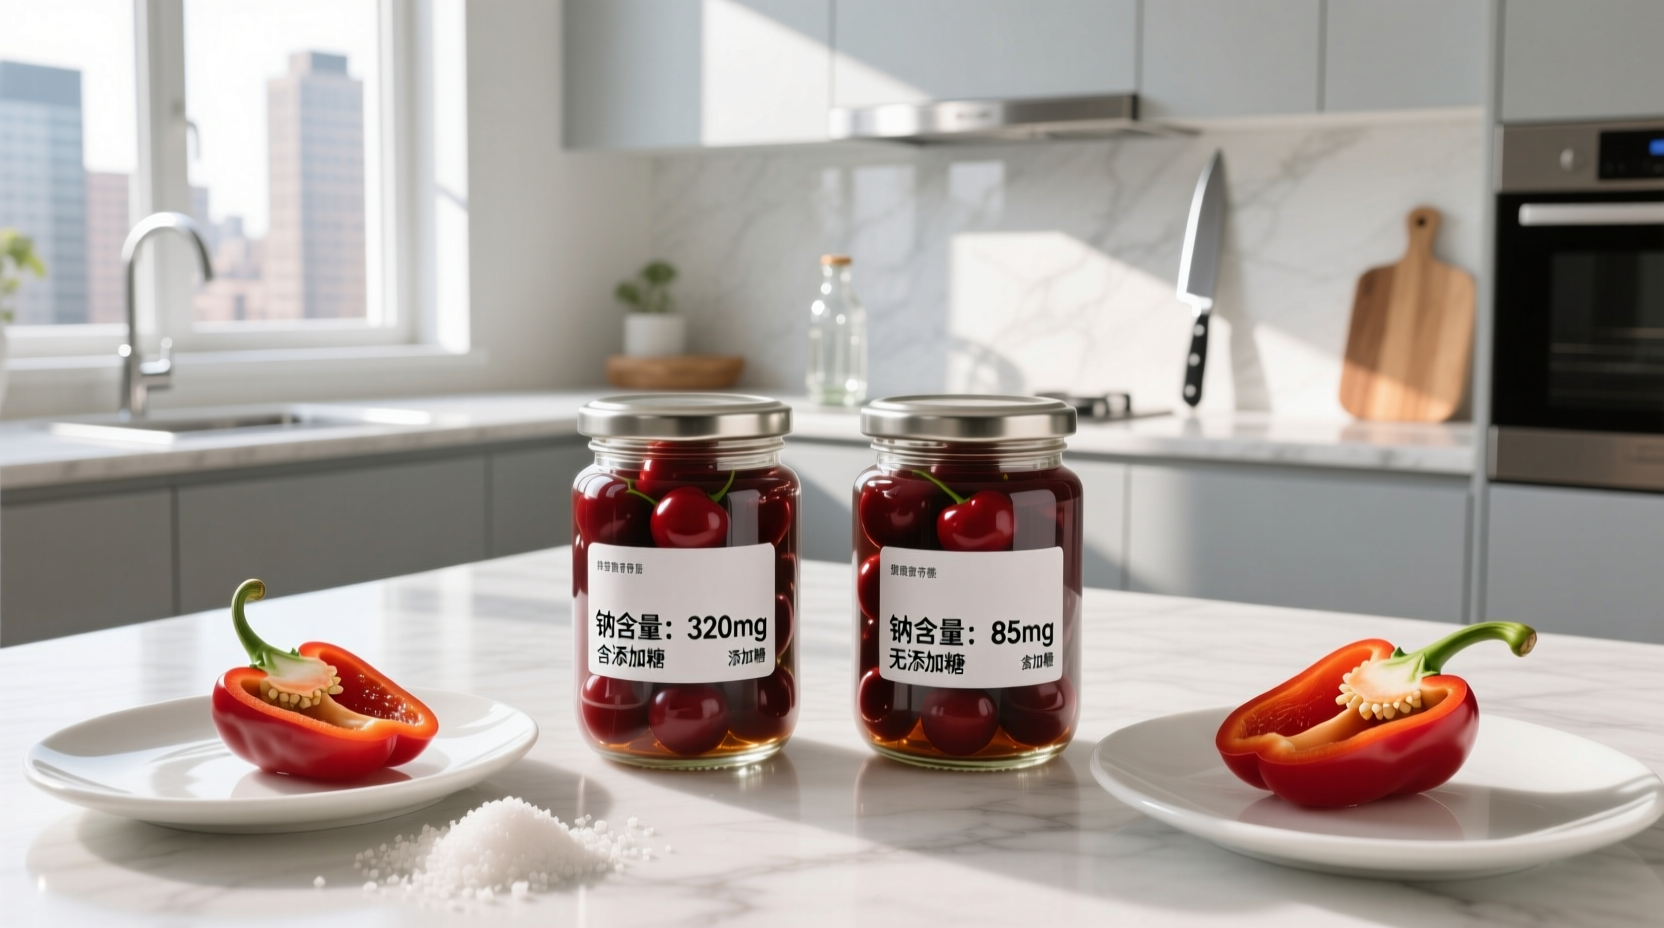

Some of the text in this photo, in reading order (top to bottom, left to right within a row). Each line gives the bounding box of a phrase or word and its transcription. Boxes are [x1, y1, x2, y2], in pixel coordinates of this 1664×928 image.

[597, 644, 665, 669] 含添加糖
[889, 647, 966, 675] 无添加糖
